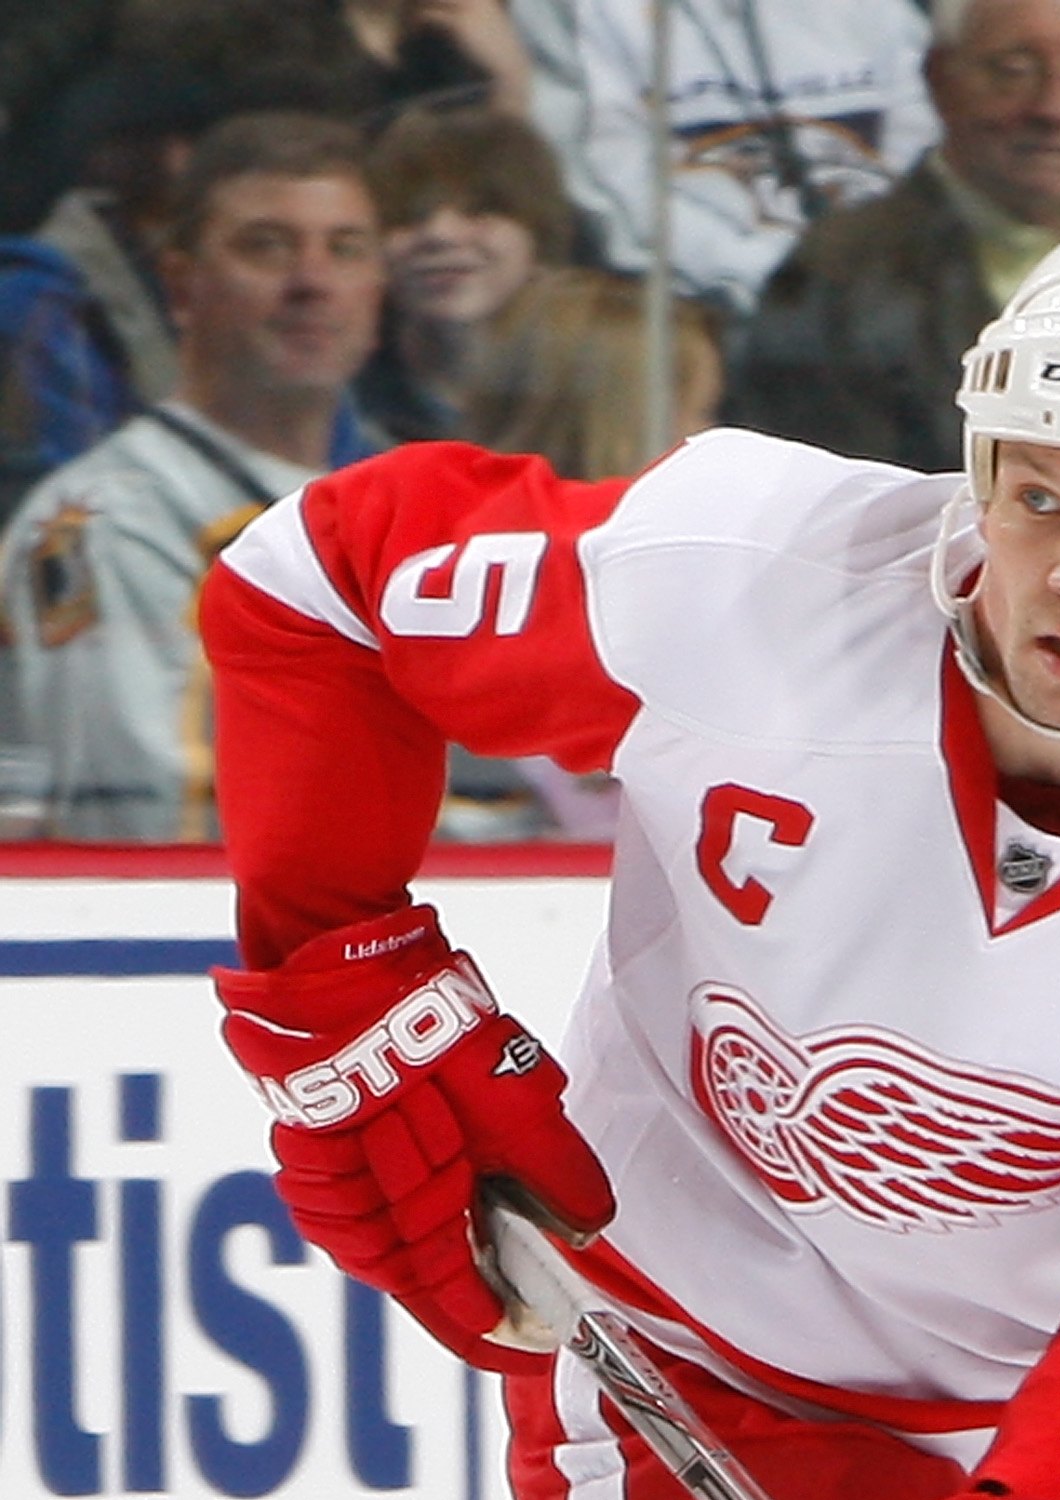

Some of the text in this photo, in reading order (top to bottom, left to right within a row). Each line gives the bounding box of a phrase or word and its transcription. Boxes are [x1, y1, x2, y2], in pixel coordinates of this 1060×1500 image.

[380, 532, 549, 637] 5
[695, 781, 817, 926] C
[246, 955, 498, 1129] ASTON
[6, 1071, 414, 1499] tist
